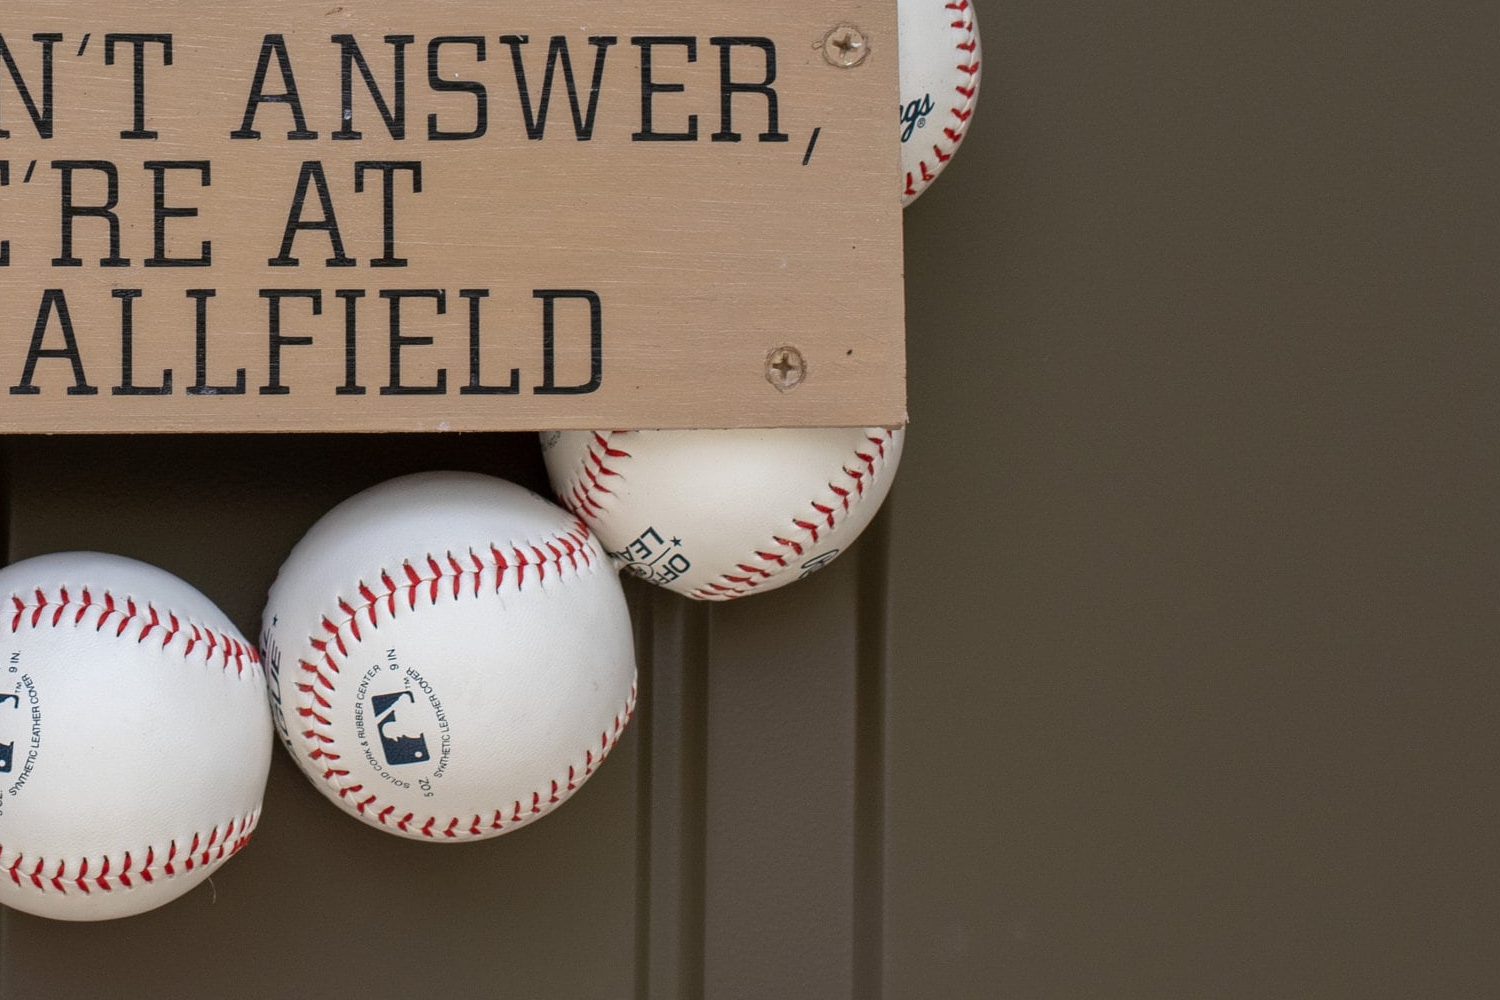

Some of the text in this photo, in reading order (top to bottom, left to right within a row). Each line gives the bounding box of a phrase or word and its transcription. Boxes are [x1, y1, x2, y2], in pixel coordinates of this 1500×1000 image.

[231, 33, 822, 166] ANSWER,
[268, 160, 422, 267] AT
[357, 664, 382, 701] CENTER
[8, 673, 41, 796] SYNTHETIC LEATHER COVER
[355, 702, 365, 739] RUBBER
[406, 667, 451, 779] SYNTHETIC LEATHER COVER
[364, 748, 382, 771] CORK
[380, 771, 410, 790] SOLID
